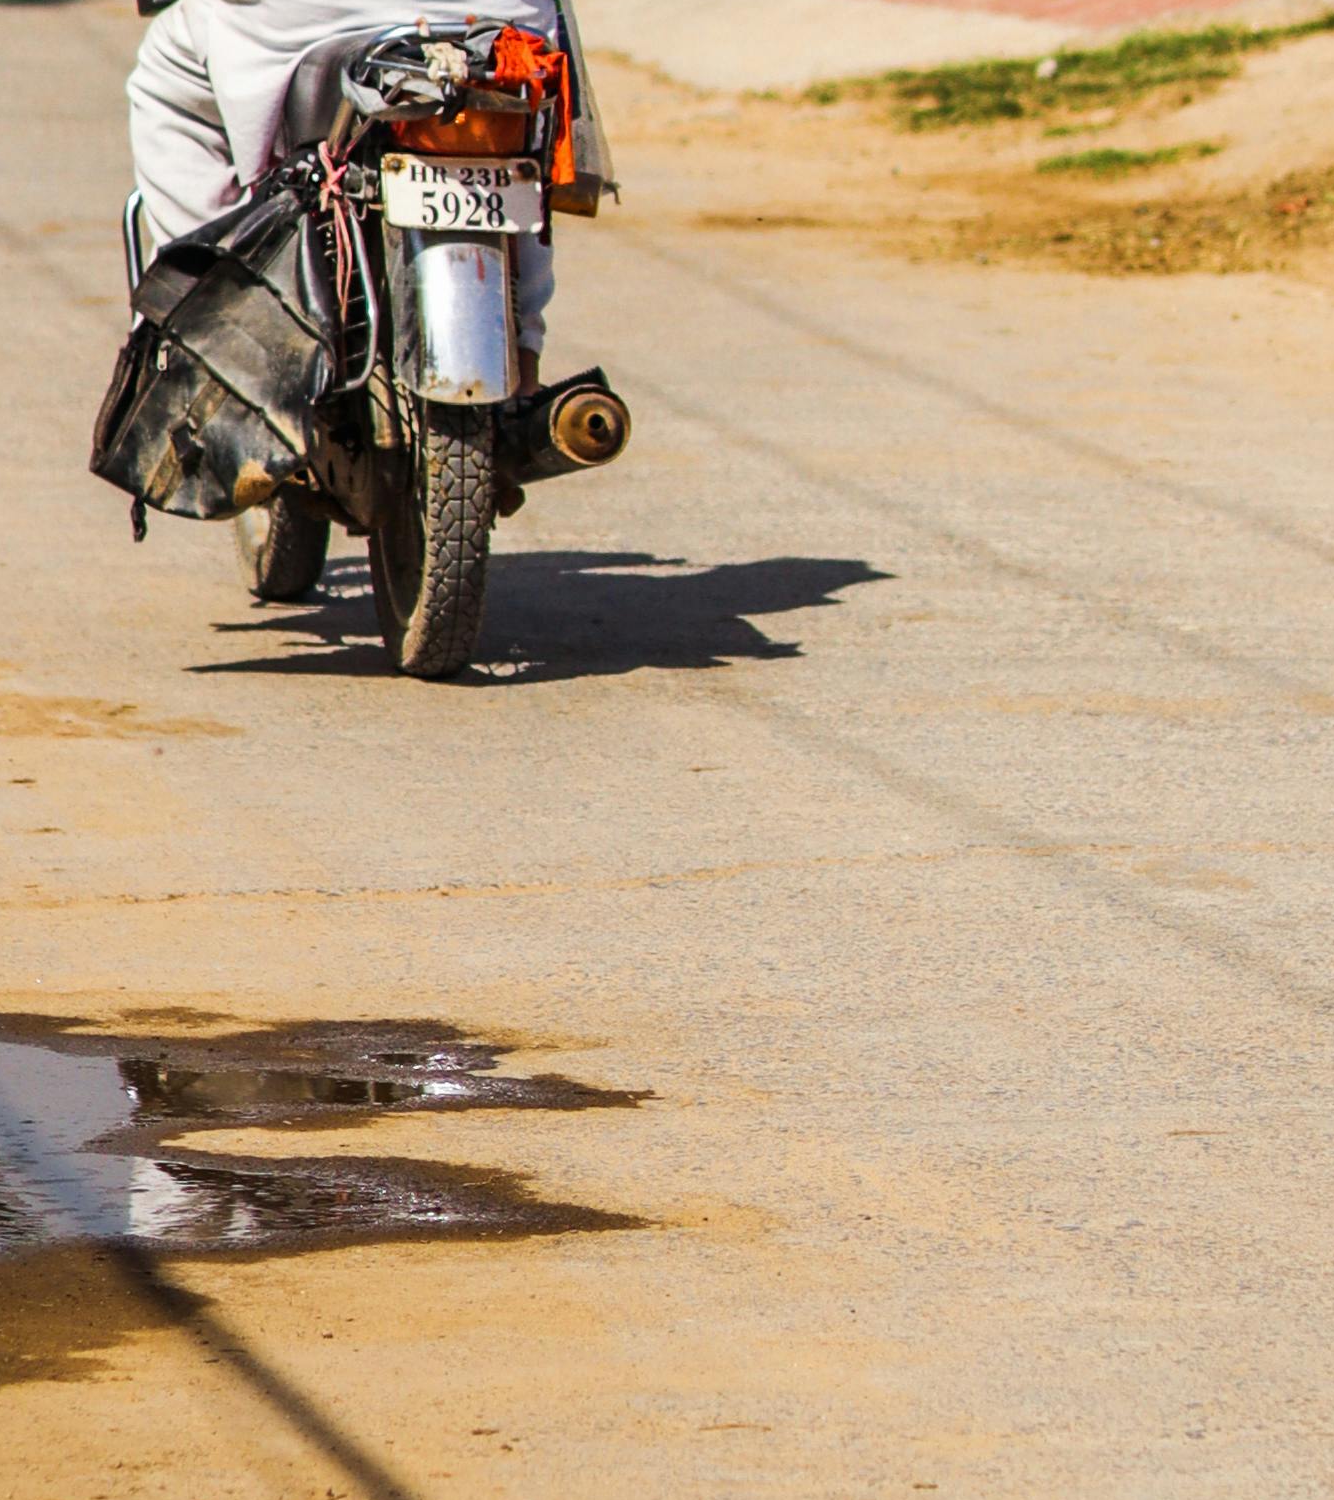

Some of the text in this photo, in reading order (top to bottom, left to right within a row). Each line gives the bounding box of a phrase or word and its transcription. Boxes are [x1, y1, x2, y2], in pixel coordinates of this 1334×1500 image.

[410, 164, 512, 188] HR 23B
[422, 190, 506, 229] 5928
